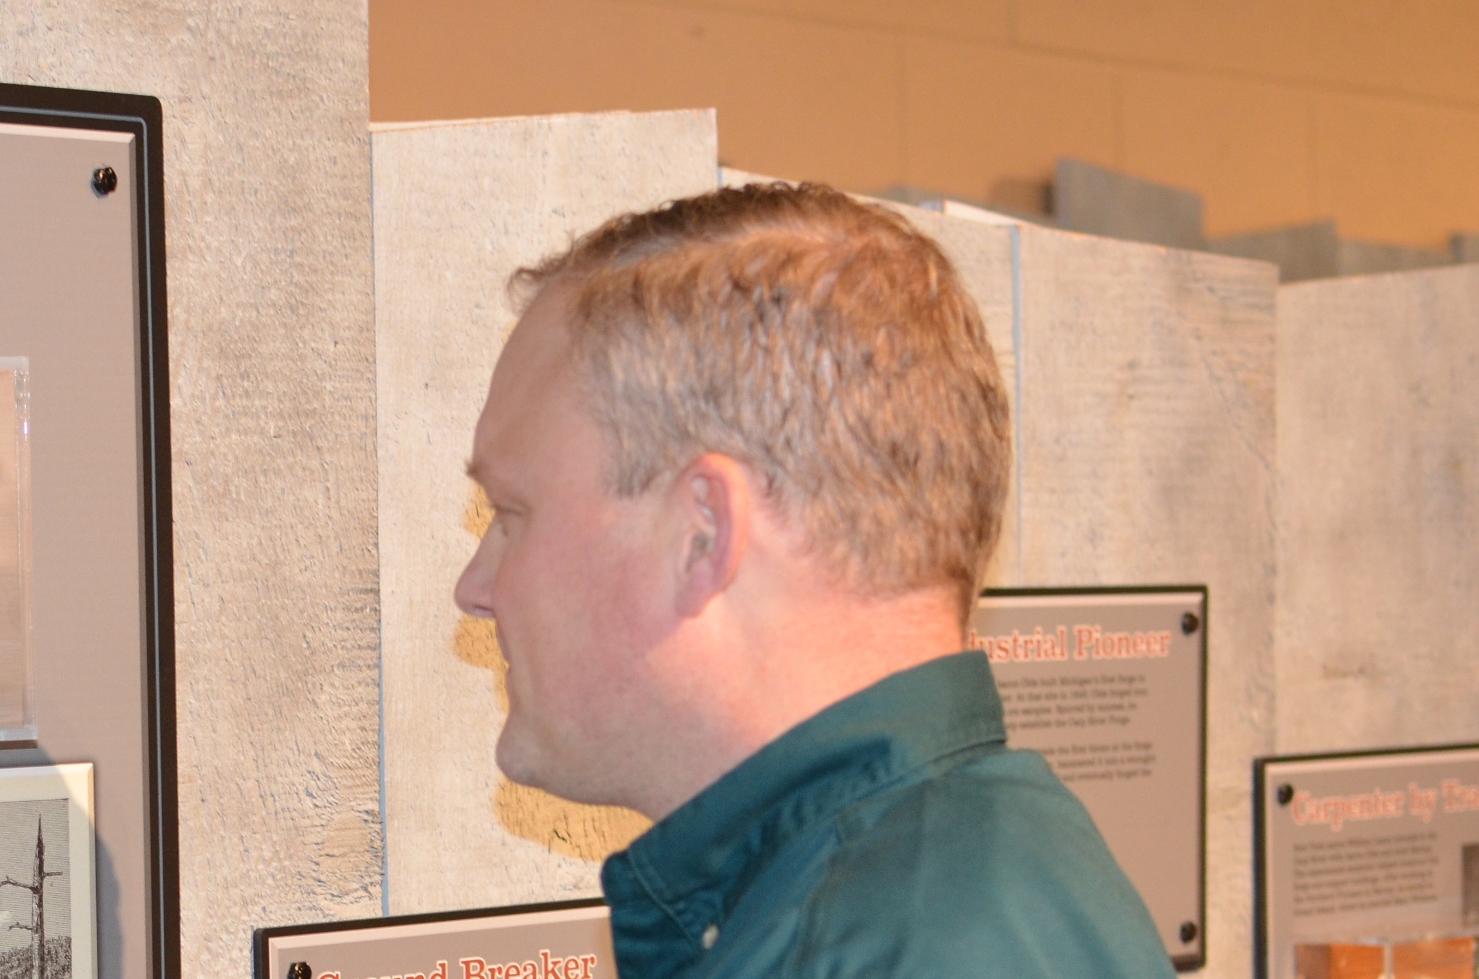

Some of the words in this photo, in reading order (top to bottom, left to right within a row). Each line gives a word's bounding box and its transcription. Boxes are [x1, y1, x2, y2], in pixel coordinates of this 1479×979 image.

[1073, 624, 1172, 660] Pioneer
[1292, 791, 1405, 831] Carpenter
[1409, 783, 1436, 822] by
